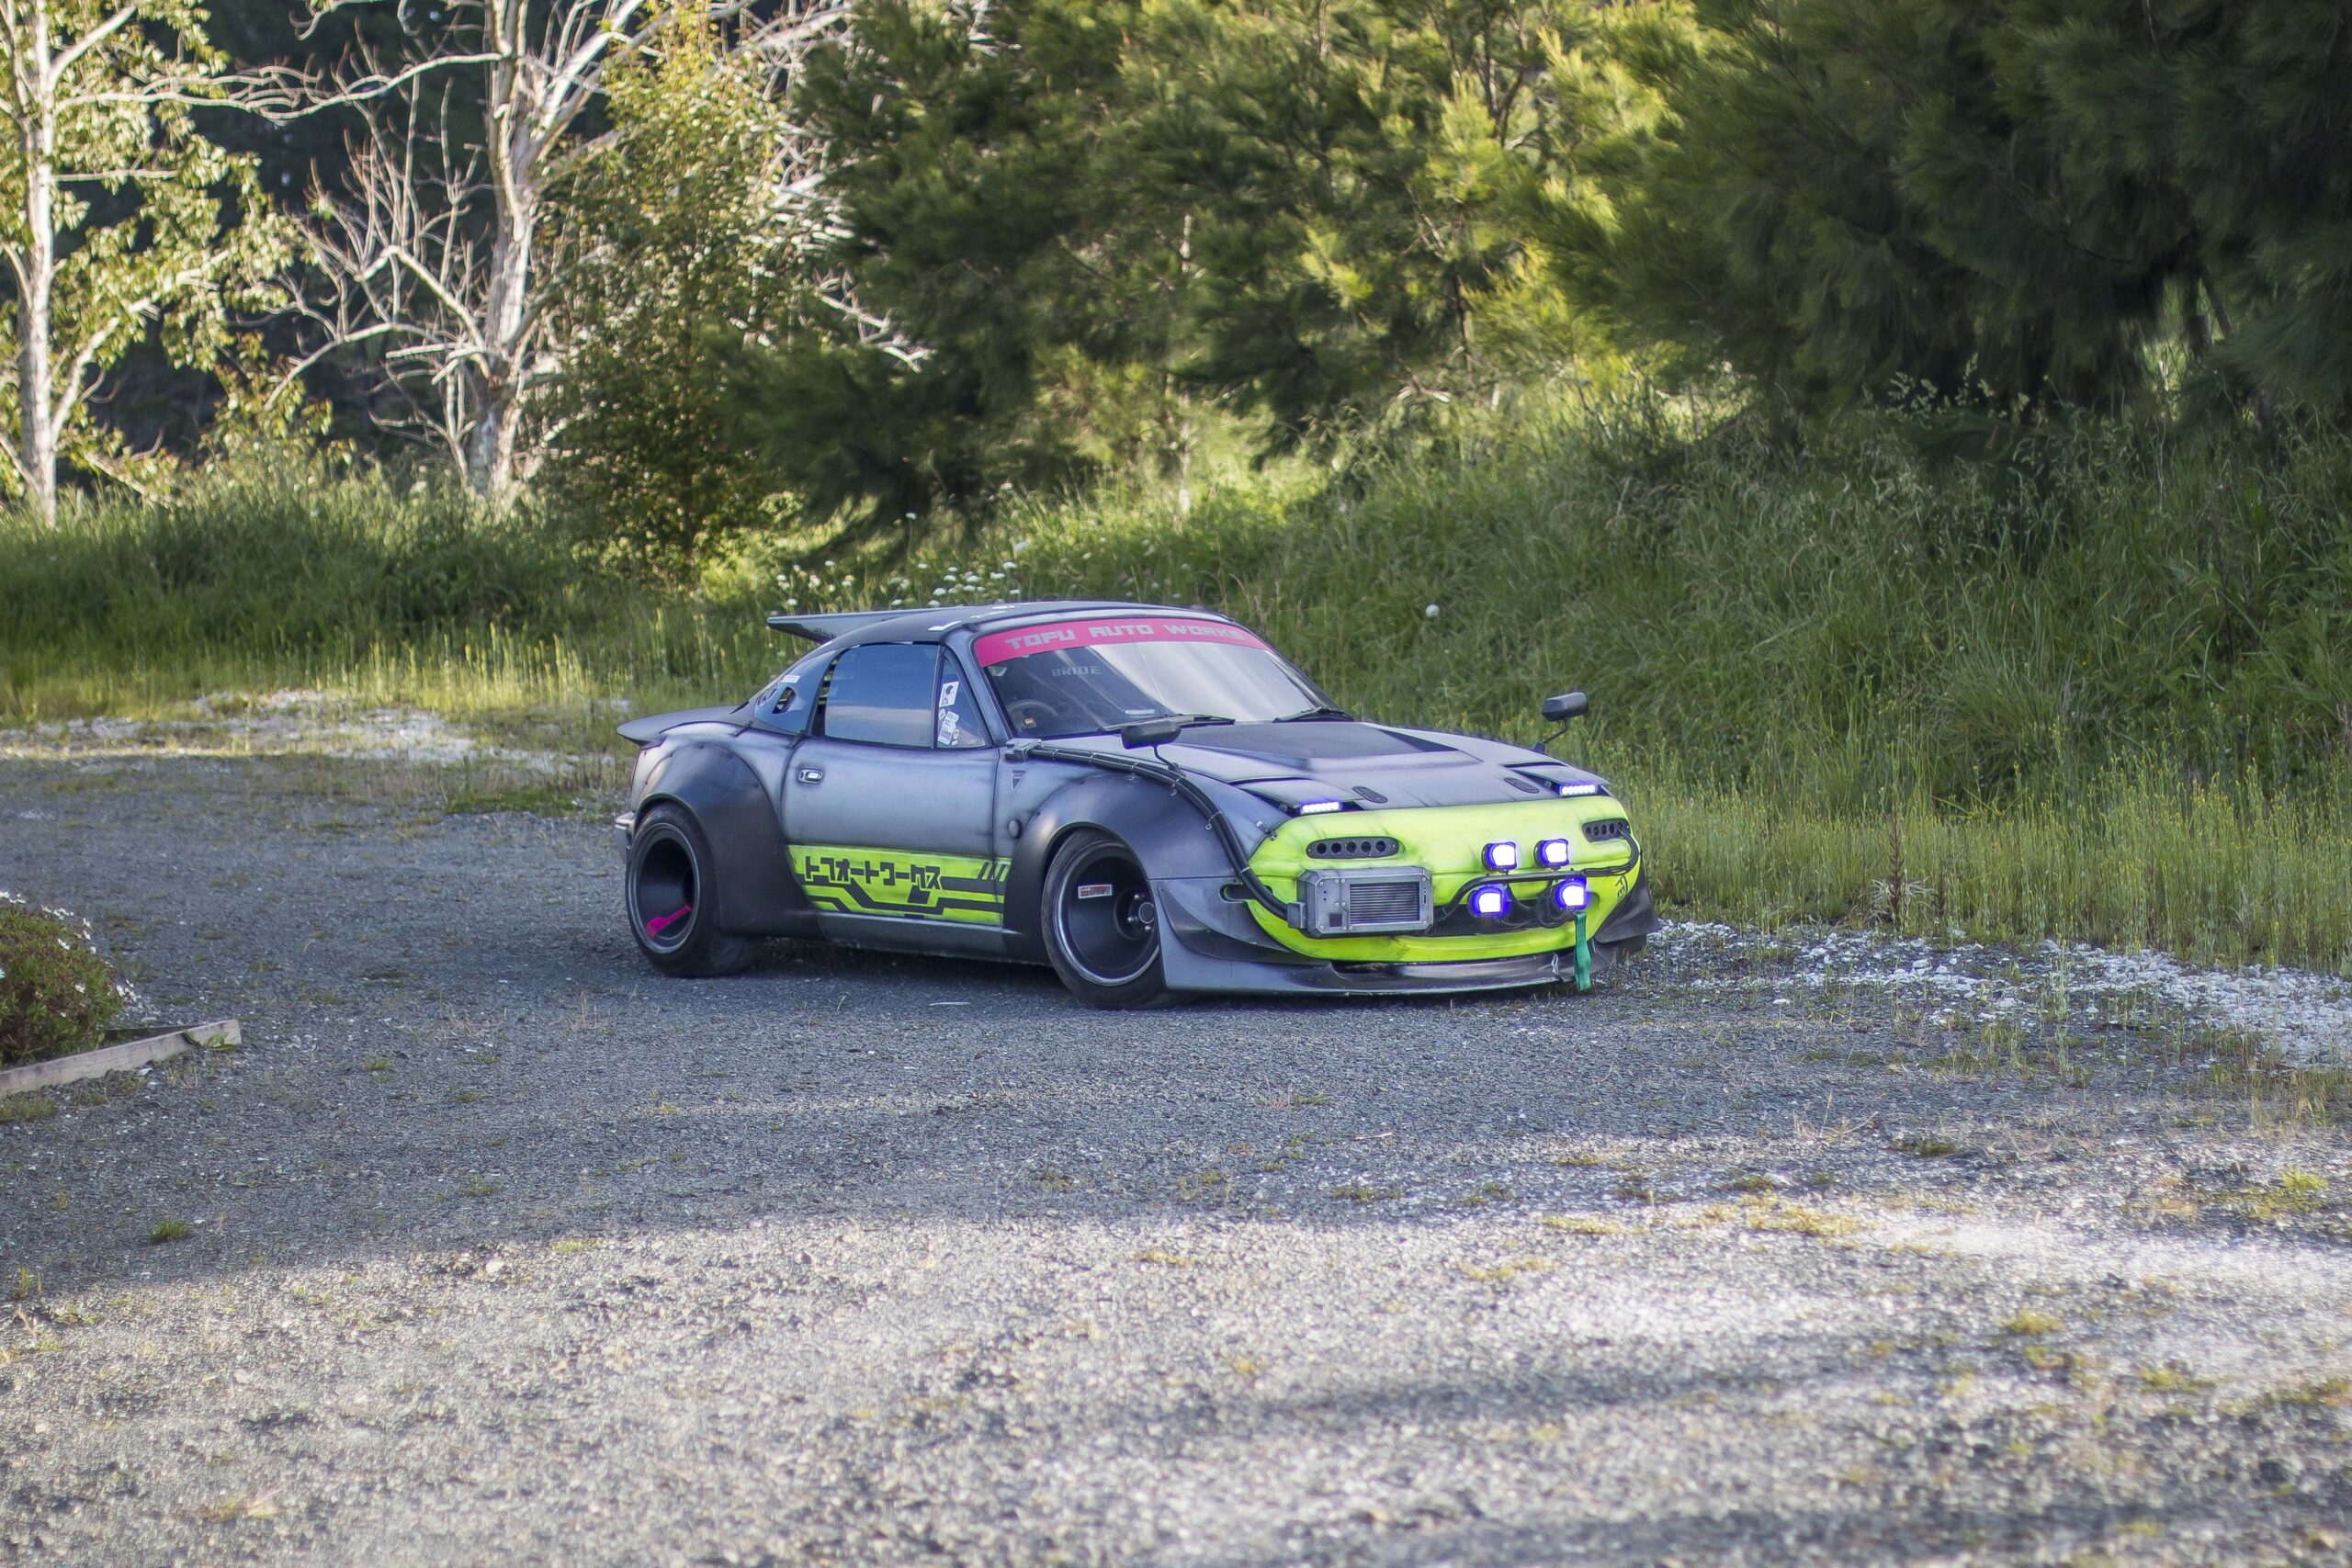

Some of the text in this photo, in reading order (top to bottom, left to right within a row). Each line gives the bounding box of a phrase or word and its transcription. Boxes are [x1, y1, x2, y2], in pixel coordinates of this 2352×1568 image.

[1005, 625, 1245, 649] TOFU AUTO WORKS
[1051, 666, 1102, 677] BRIDE
